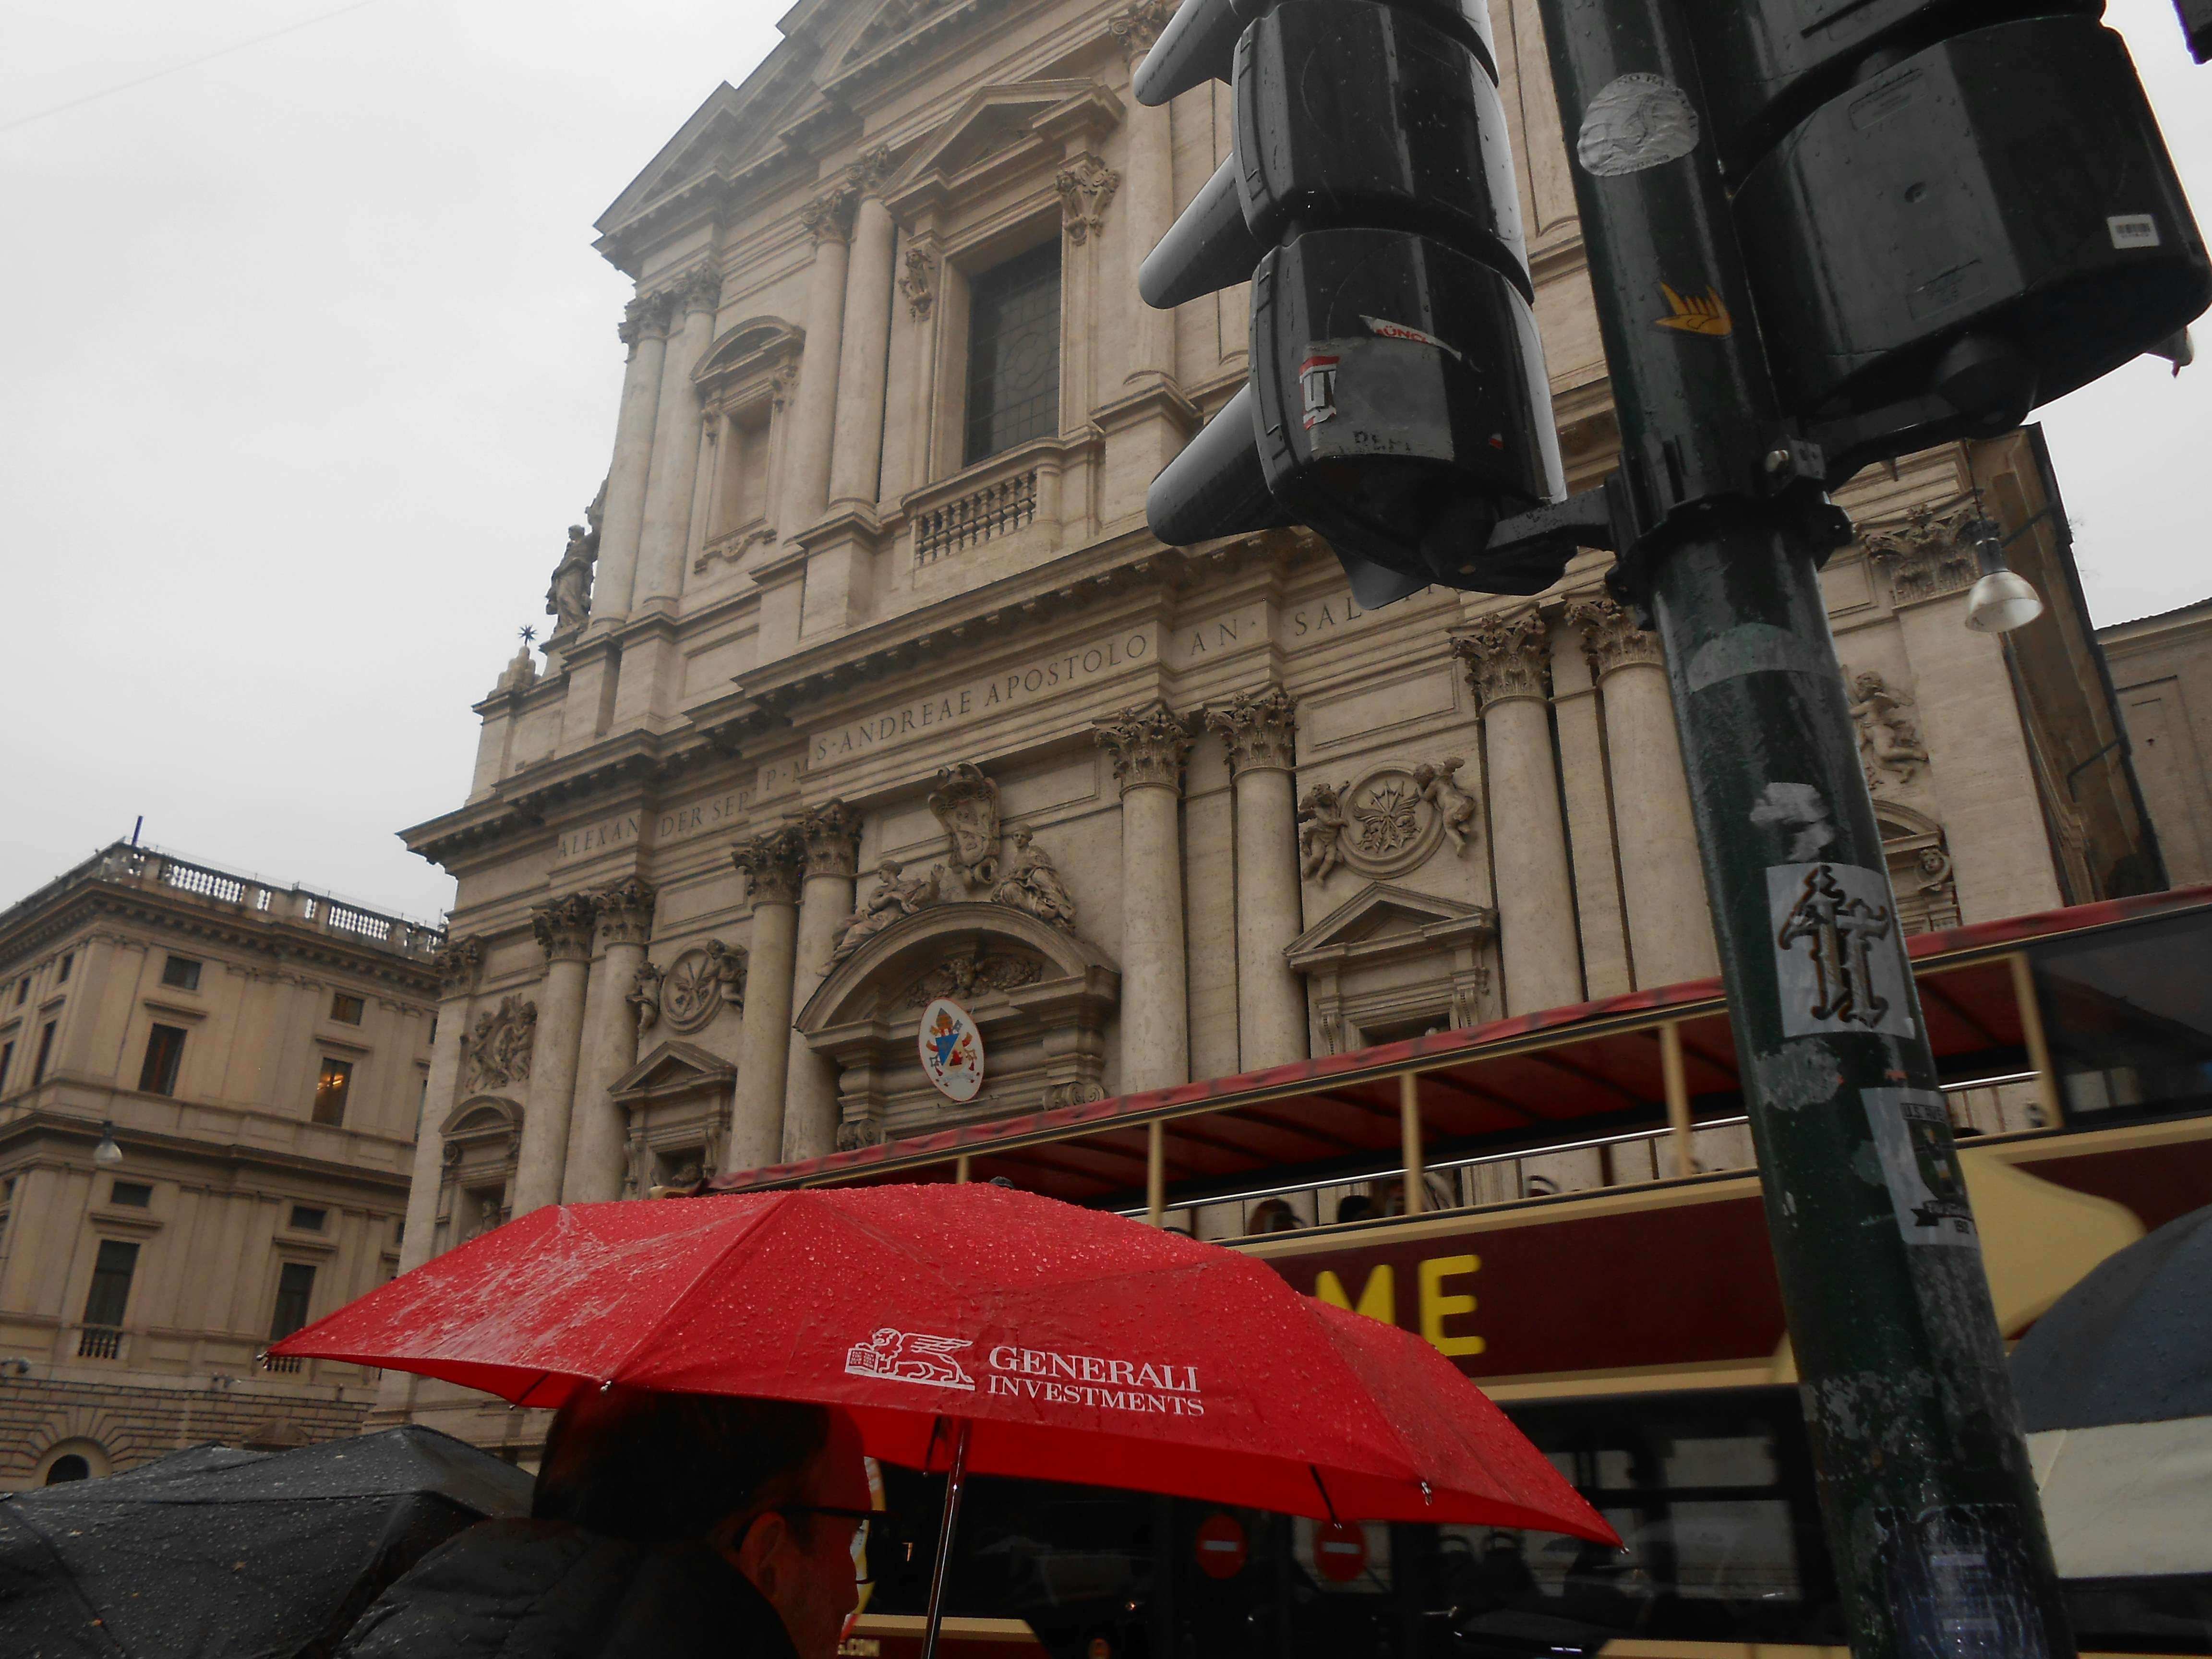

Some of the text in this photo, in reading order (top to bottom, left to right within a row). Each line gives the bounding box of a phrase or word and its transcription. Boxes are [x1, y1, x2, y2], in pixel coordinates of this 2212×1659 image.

[985, 635, 1146, 707] APOSTOLO
[989, 1346, 1201, 1393] GENERALI
[987, 1374, 1204, 1417] INVESTMENTS
